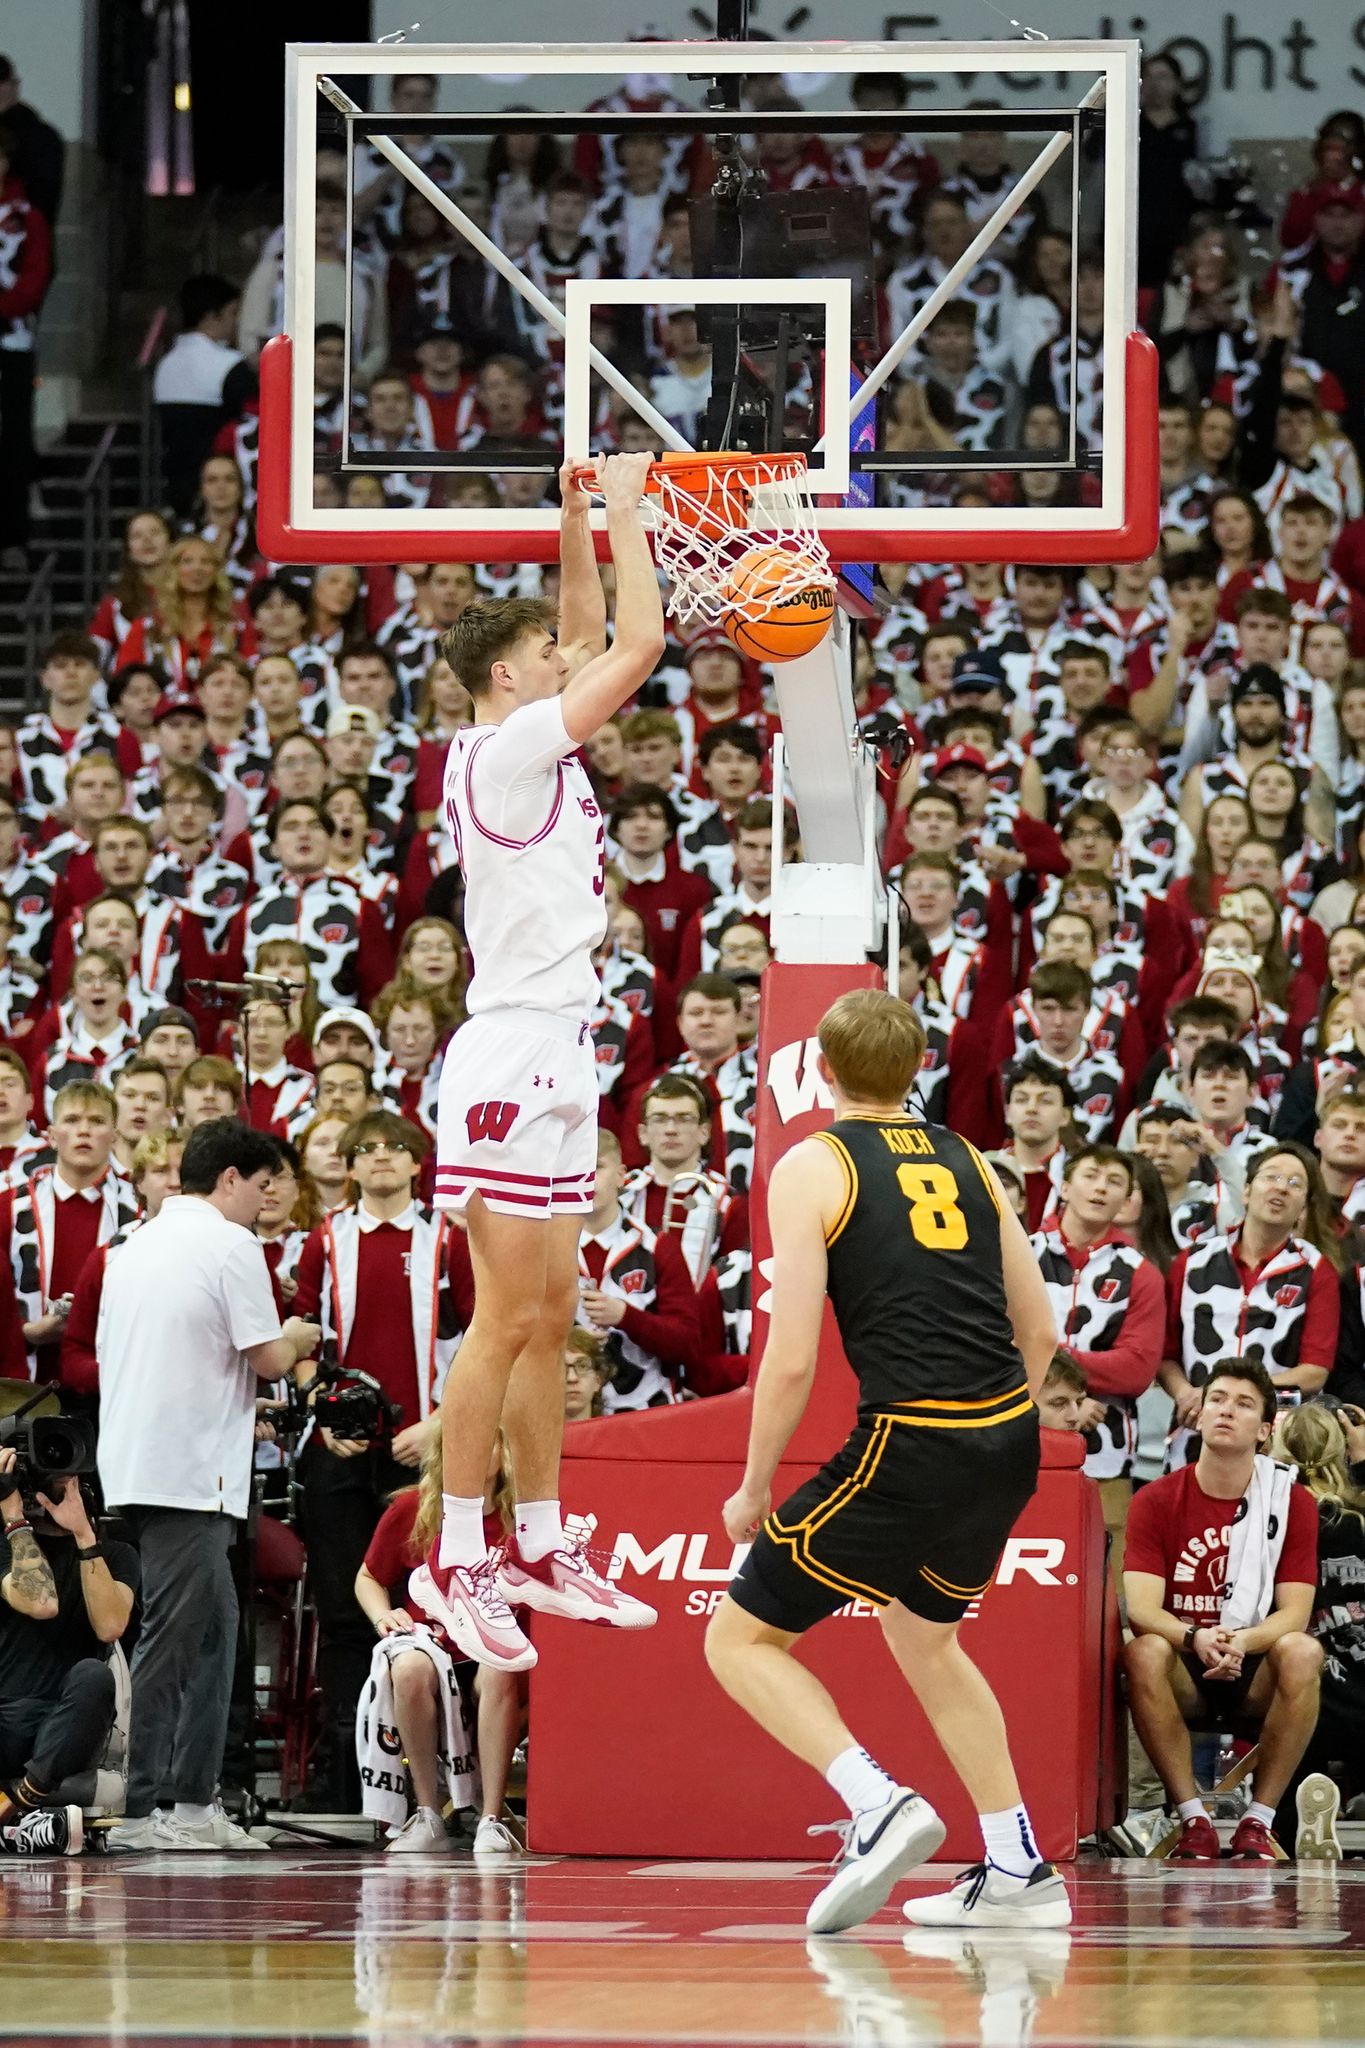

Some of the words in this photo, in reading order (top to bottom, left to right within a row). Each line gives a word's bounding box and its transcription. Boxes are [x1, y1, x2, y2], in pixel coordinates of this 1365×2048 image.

[465, 1101, 521, 1146] W
[879, 1128, 936, 1155] KOCH
[896, 1162, 969, 1250] 8
[1173, 1525, 1233, 1582] WISCO
